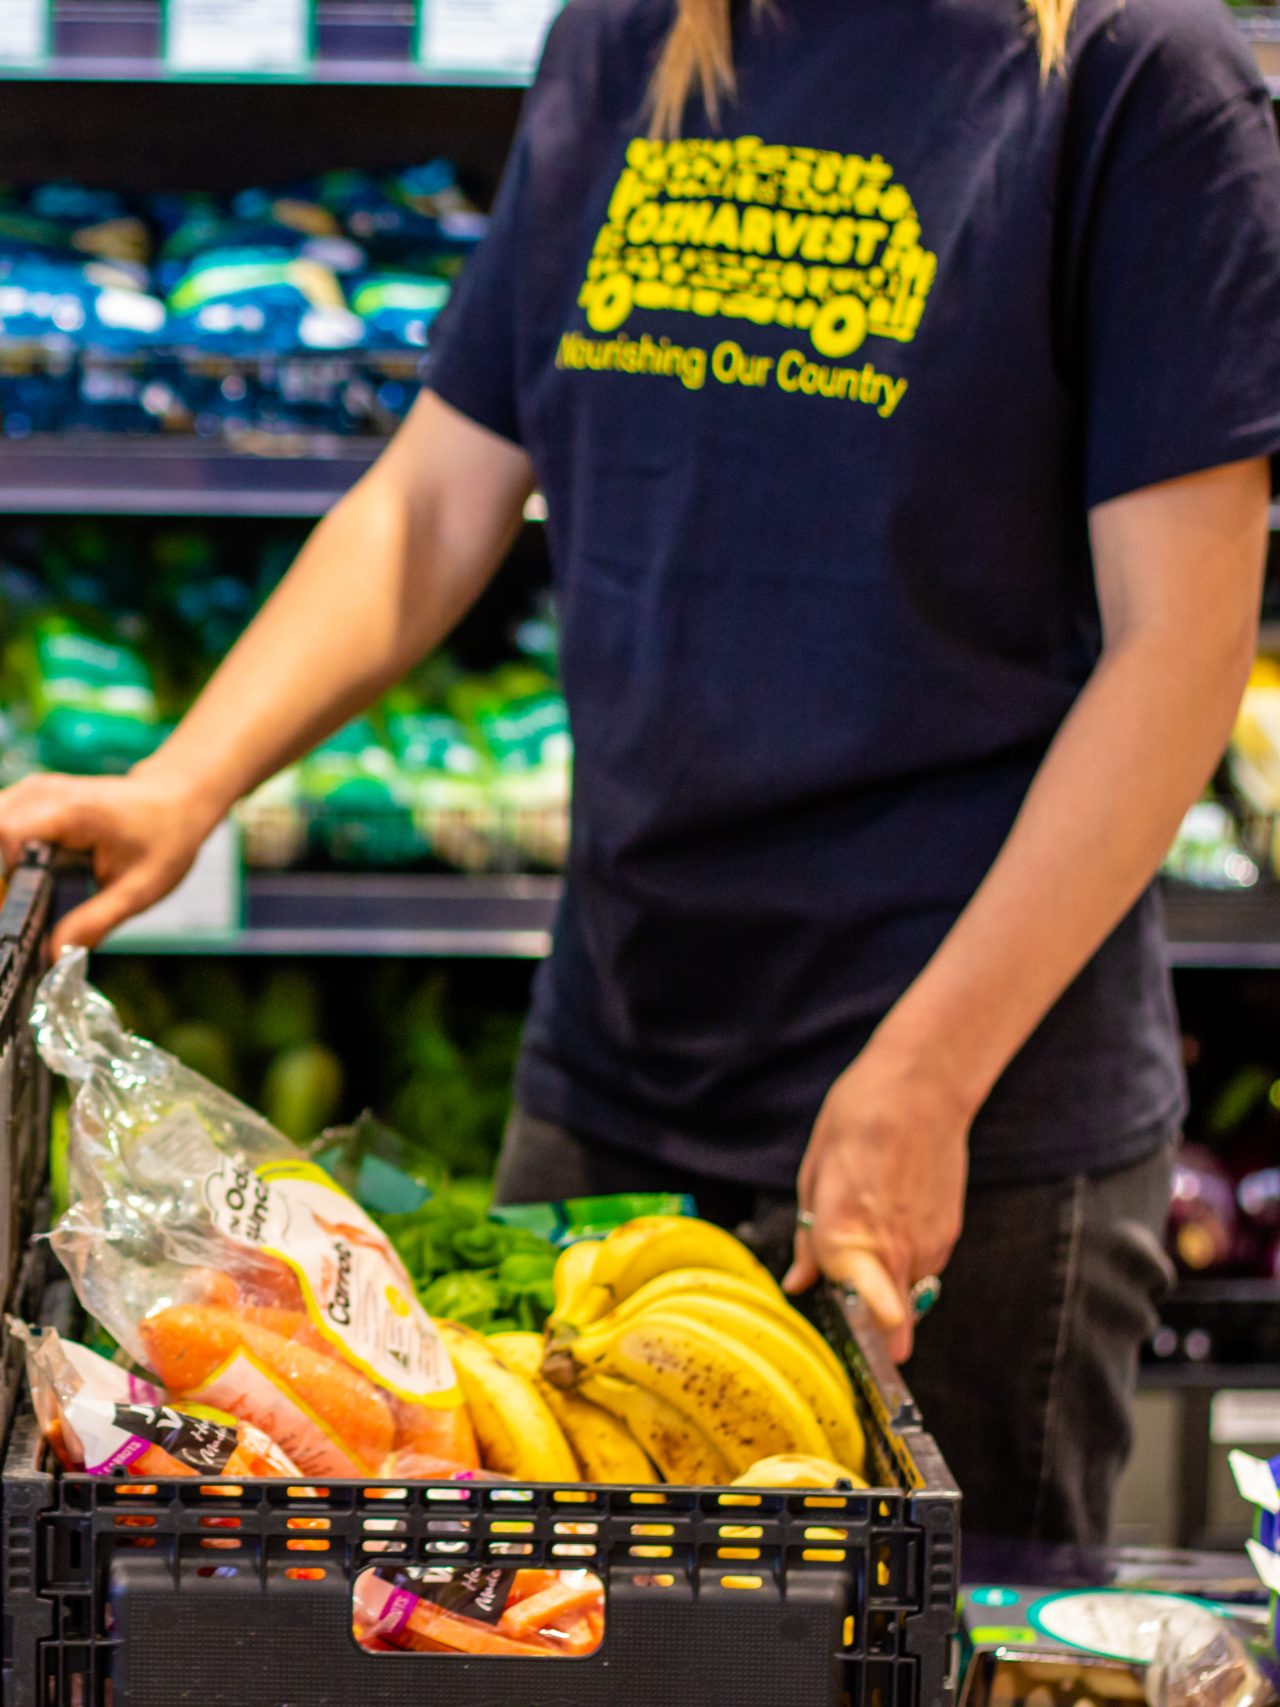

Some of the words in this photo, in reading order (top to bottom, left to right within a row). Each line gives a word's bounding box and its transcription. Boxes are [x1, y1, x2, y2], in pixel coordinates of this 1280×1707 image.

[626, 201, 890, 266] OZHARVEST
[555, 331, 708, 390] Nourishing
[712, 341, 773, 387] Our
[776, 349, 910, 419] Country
